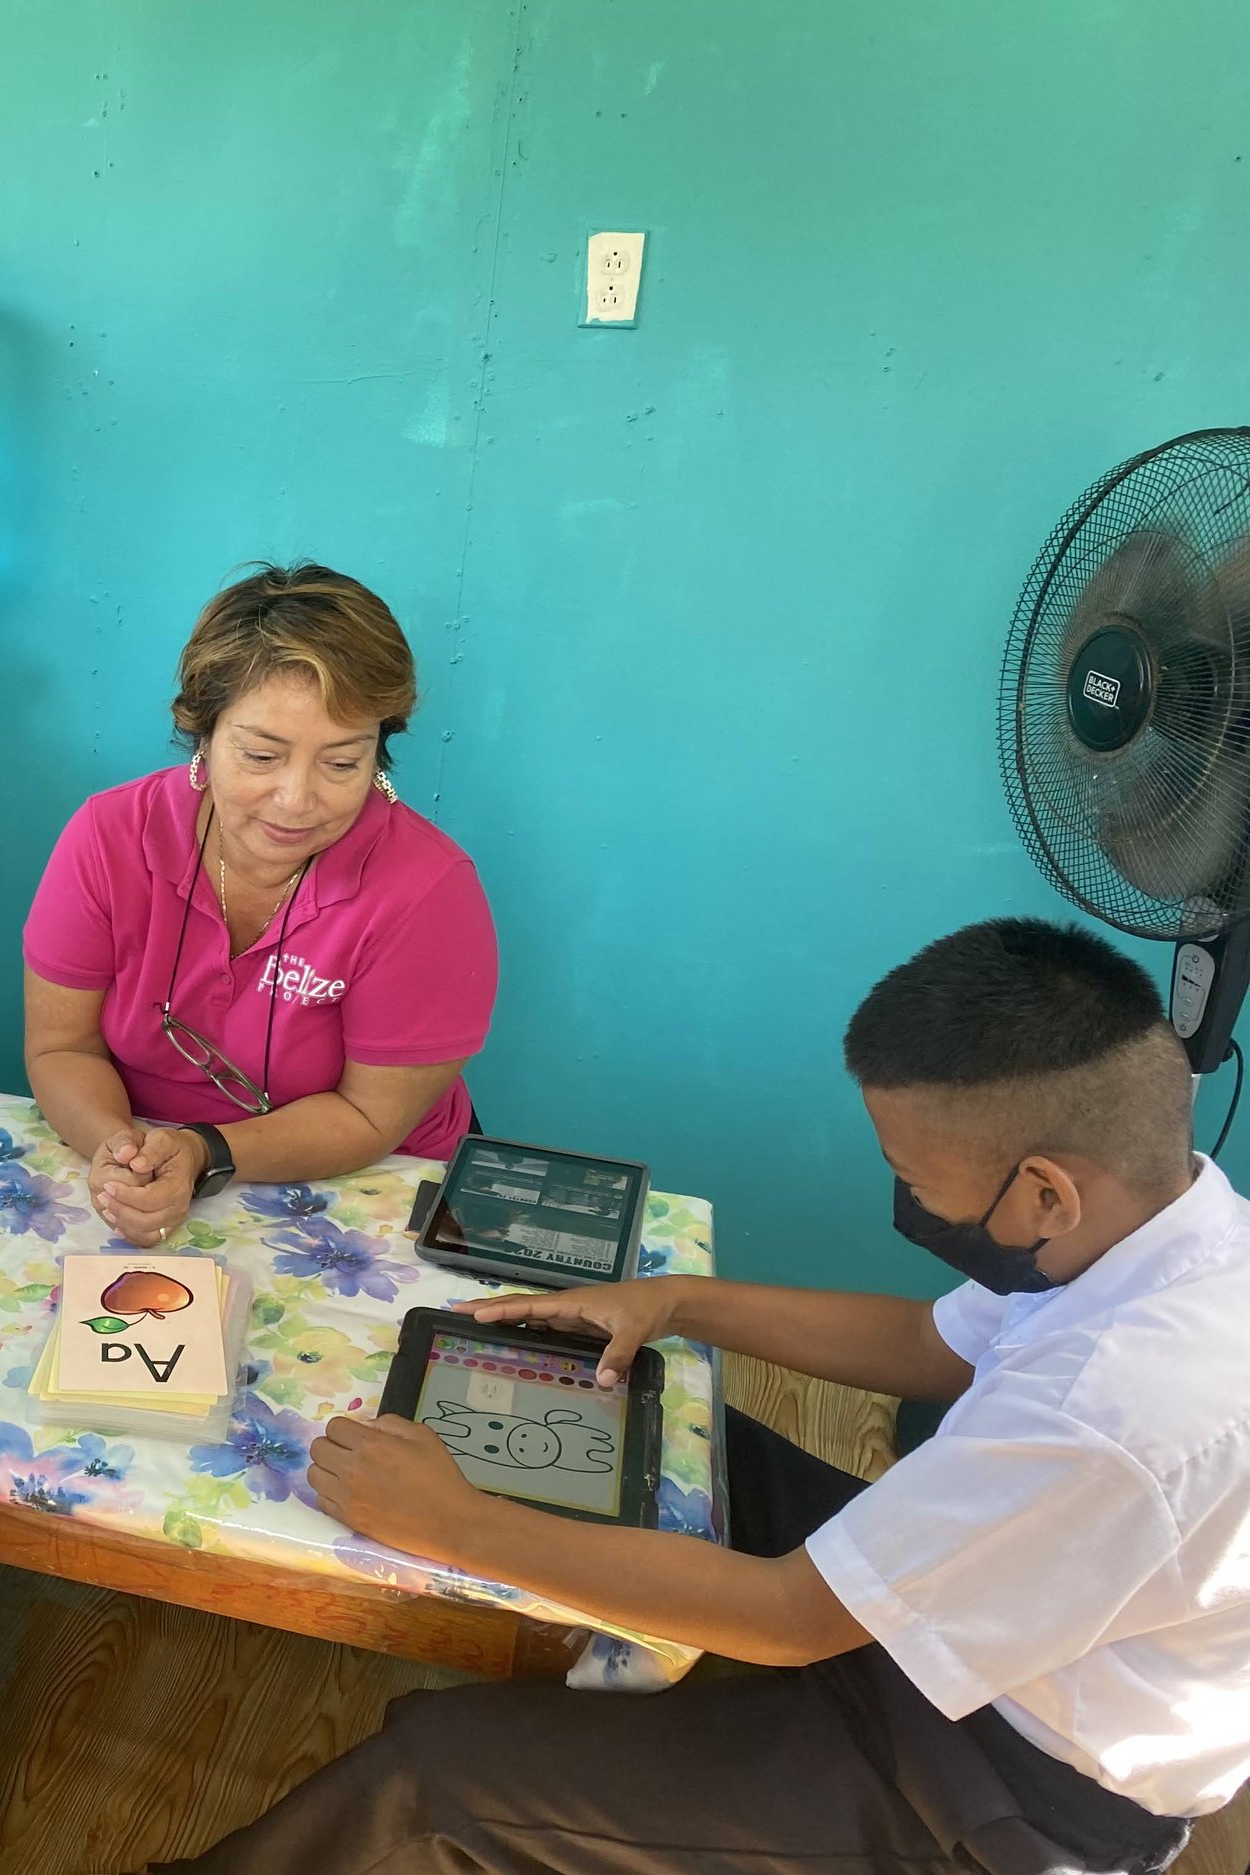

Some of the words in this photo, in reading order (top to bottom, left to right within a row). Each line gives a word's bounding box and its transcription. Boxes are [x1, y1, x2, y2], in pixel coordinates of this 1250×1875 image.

[1086, 684, 1114, 703] DECKER
[1089, 676, 1116, 692] BLACK+
[260, 954, 345, 998] Belize
[546, 1253, 612, 1271] COUNTRY
[101, 1343, 186, 1383] Aa
